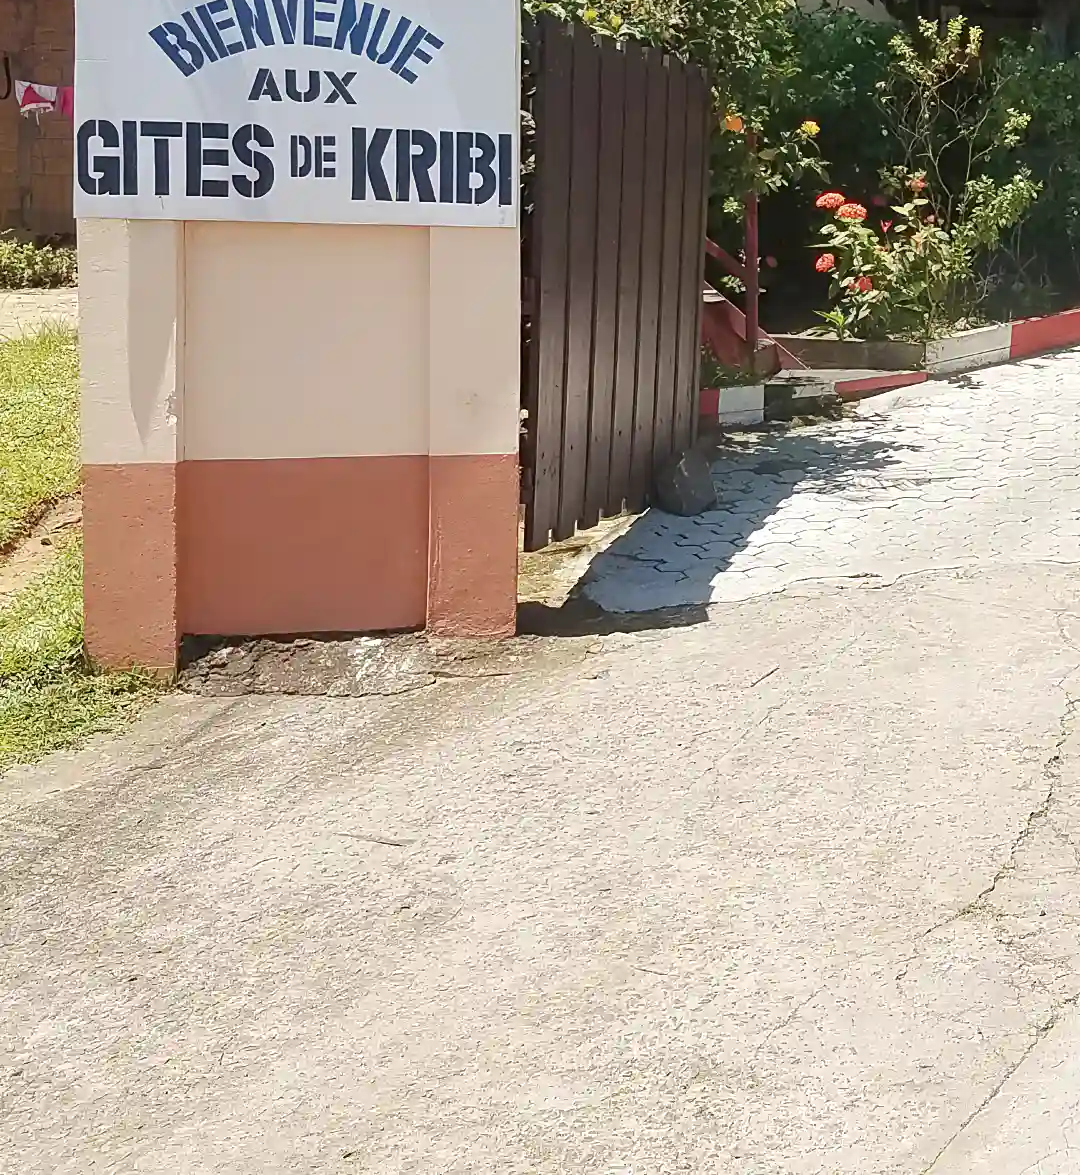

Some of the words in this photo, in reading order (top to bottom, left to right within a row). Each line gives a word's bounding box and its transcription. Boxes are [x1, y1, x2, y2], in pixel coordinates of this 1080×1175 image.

[248, 68, 357, 104] AUX
[76, 119, 275, 198] GITES
[290, 134, 336, 178] DE
[351, 127, 512, 206] KRIBI
